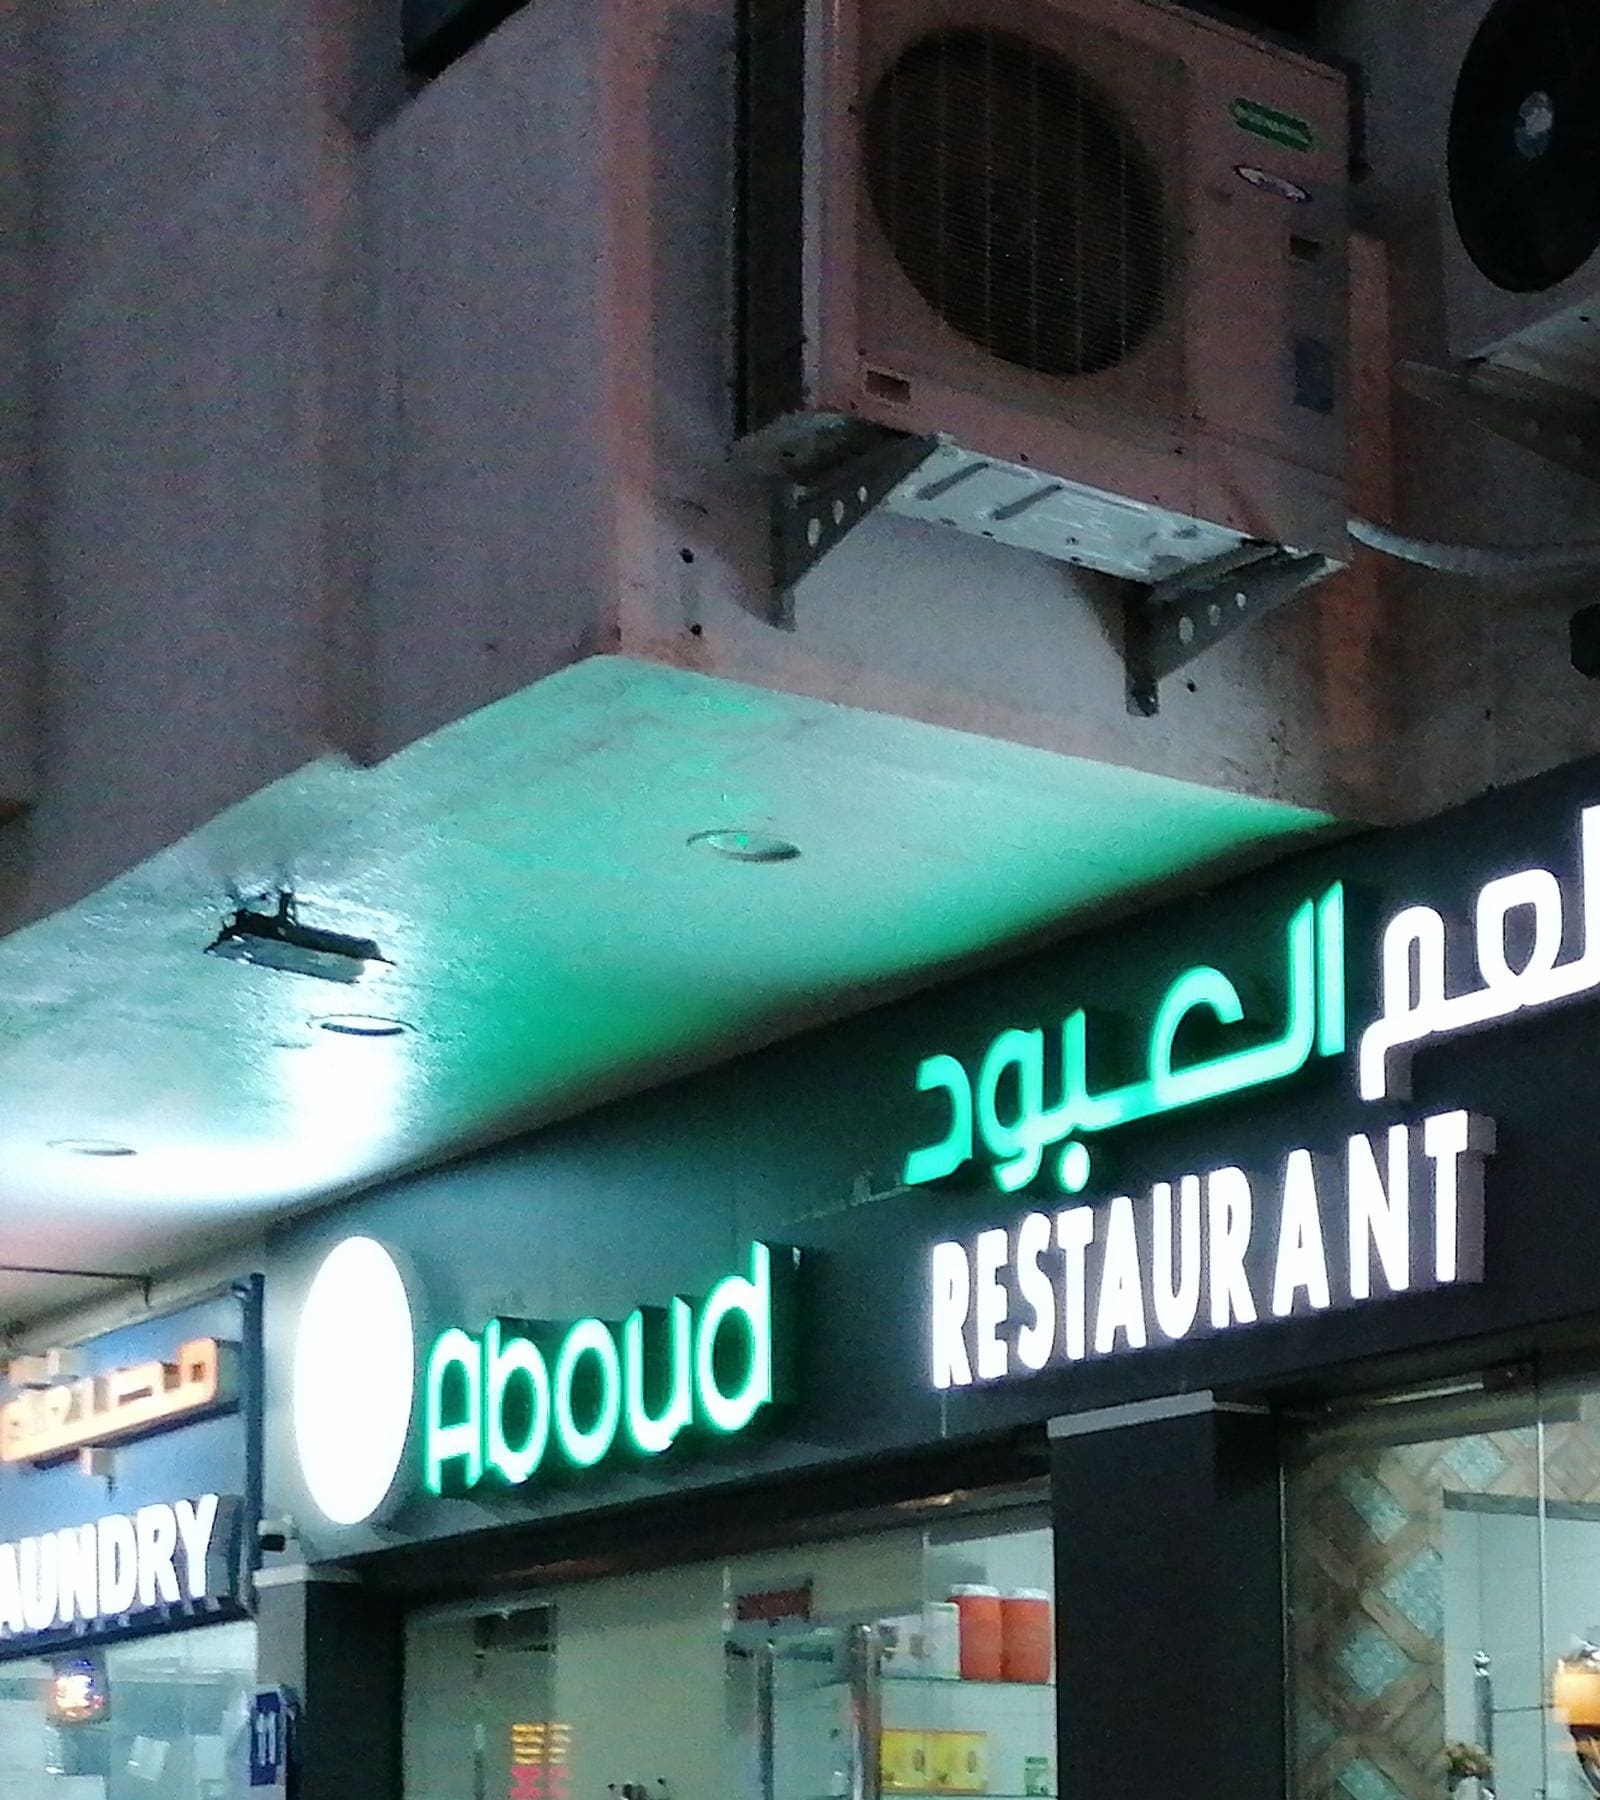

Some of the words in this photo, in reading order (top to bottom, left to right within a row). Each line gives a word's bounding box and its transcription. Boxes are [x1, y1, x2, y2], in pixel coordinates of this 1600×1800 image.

[903, 880, 1346, 1193] العبود
[425, 1240, 772, 1496] Aboud
[930, 1110, 1469, 1390] RESTAURANT
